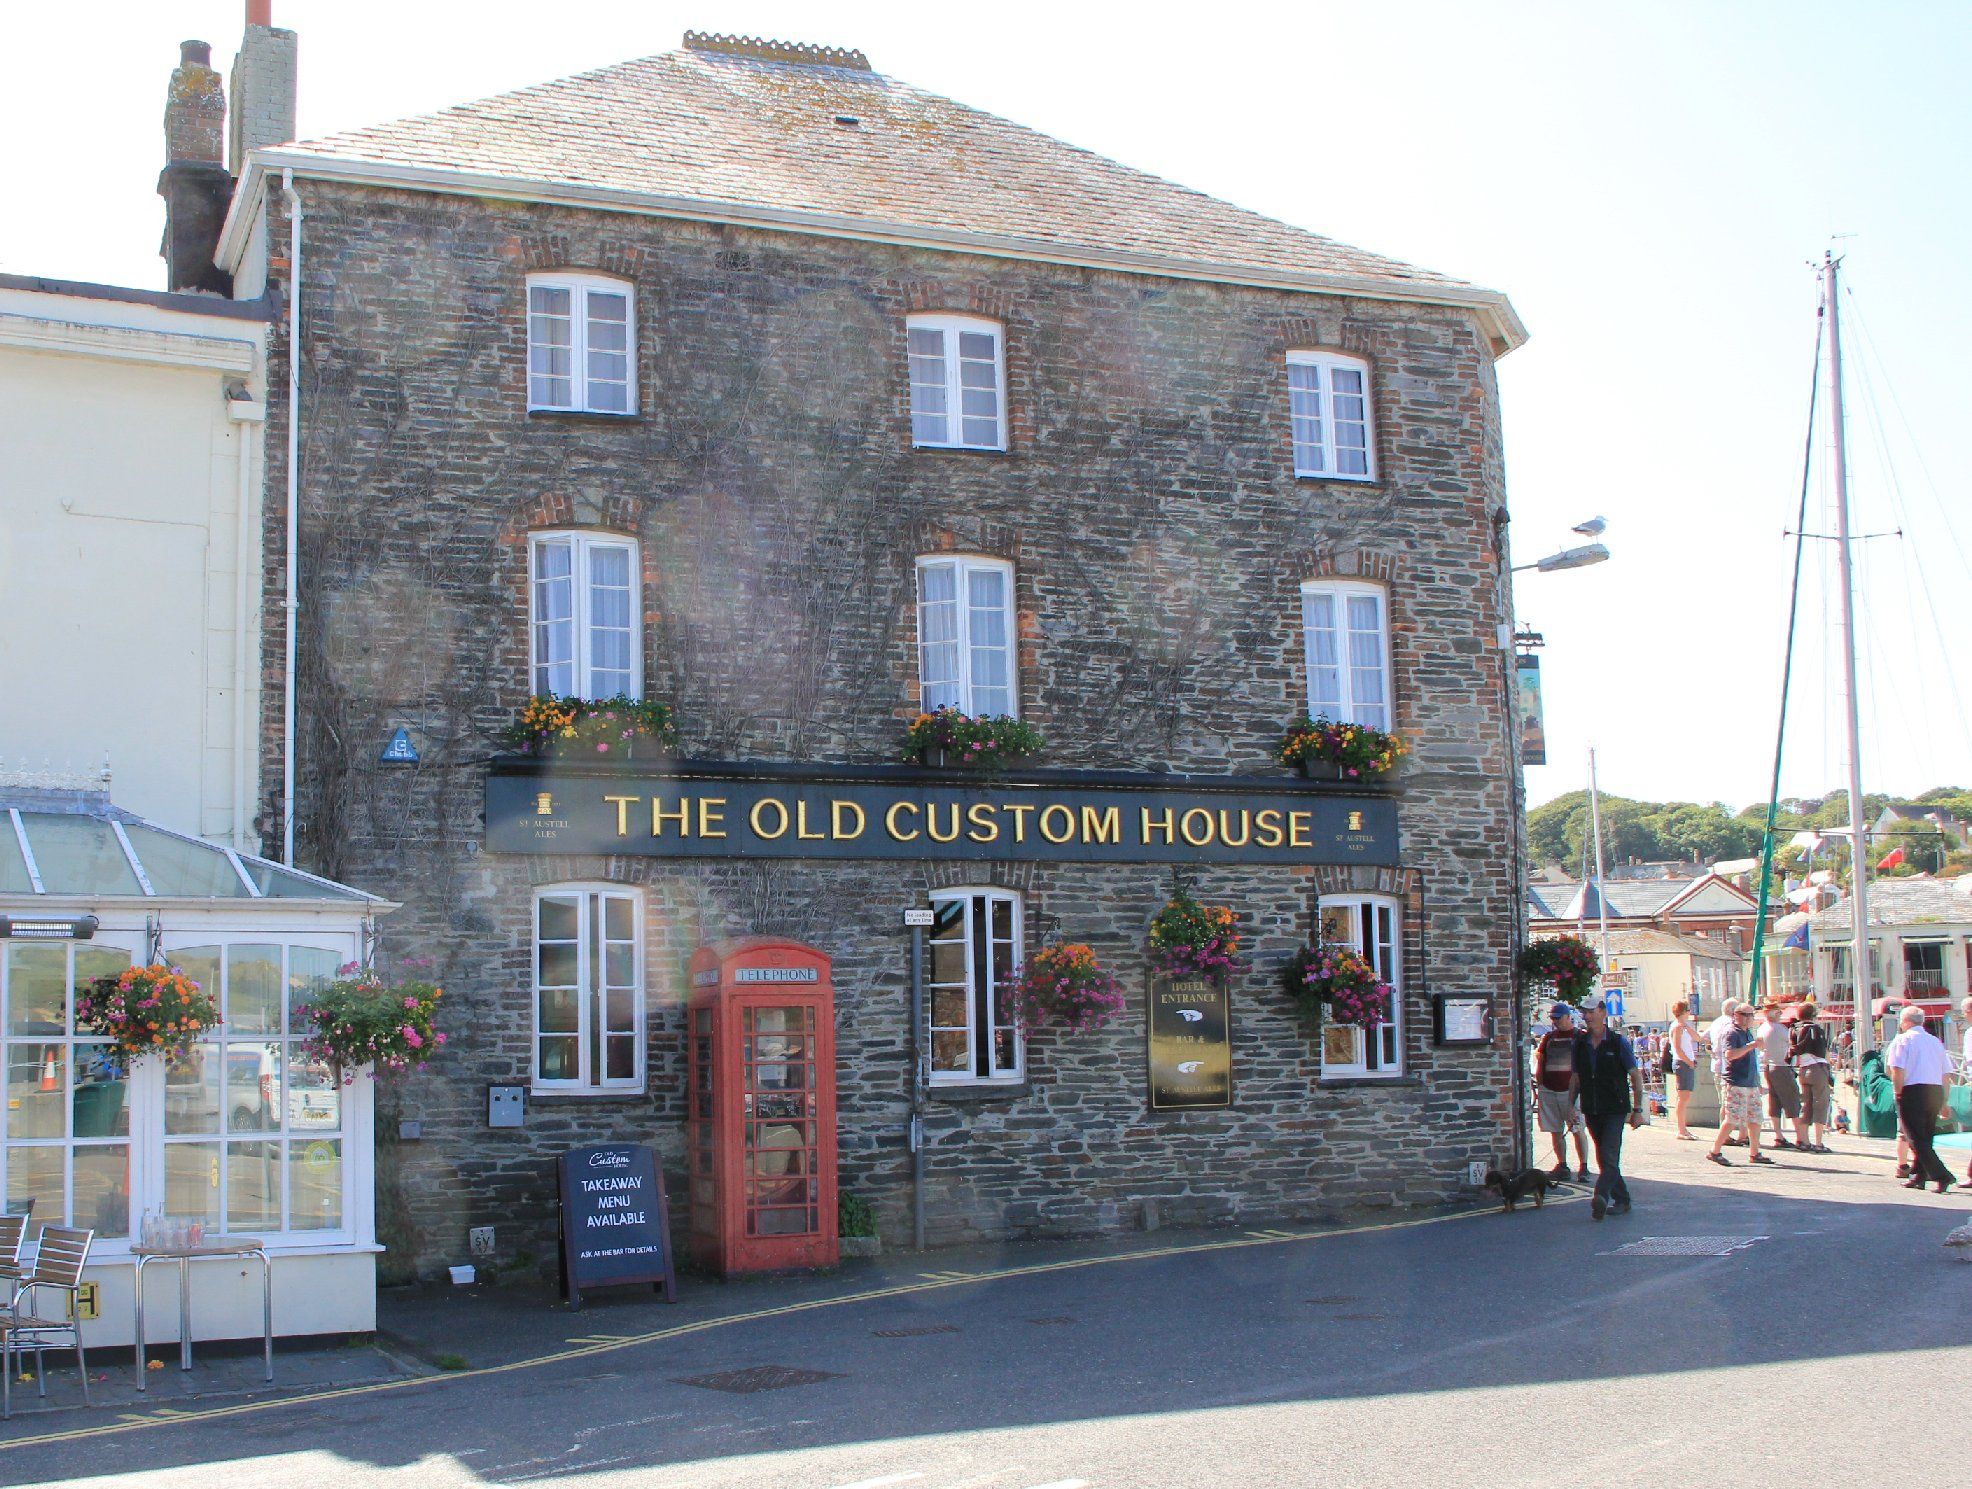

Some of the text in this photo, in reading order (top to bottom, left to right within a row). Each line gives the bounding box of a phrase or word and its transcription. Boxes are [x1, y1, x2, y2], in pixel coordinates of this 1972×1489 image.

[534, 820, 569, 828] AUSTELL
[604, 795, 1313, 848] THE OLD CUSTOM HOUSE
[534, 830, 557, 839] ALES
[1347, 834, 1375, 842] AUSTELL
[740, 967, 815, 980] TELEPHONE
[1171, 982, 1207, 992] HOTEL
[1161, 993, 1217, 1004] ENTRANCE
[1176, 1035, 1194, 1044] BAR
[589, 1152, 631, 1166] Custom
[581, 1176, 643, 1192] TAKEAWAY
[598, 1195, 631, 1209] MENU
[586, 1212, 646, 1228] AVAILABLE
[580, 1250, 593, 1259] ASK
[601, 1249, 612, 1257] THE
[612, 1248, 624, 1256] BAR
[624, 1247, 636, 1255] FOR
[636, 1245, 658, 1254] DETAILS
